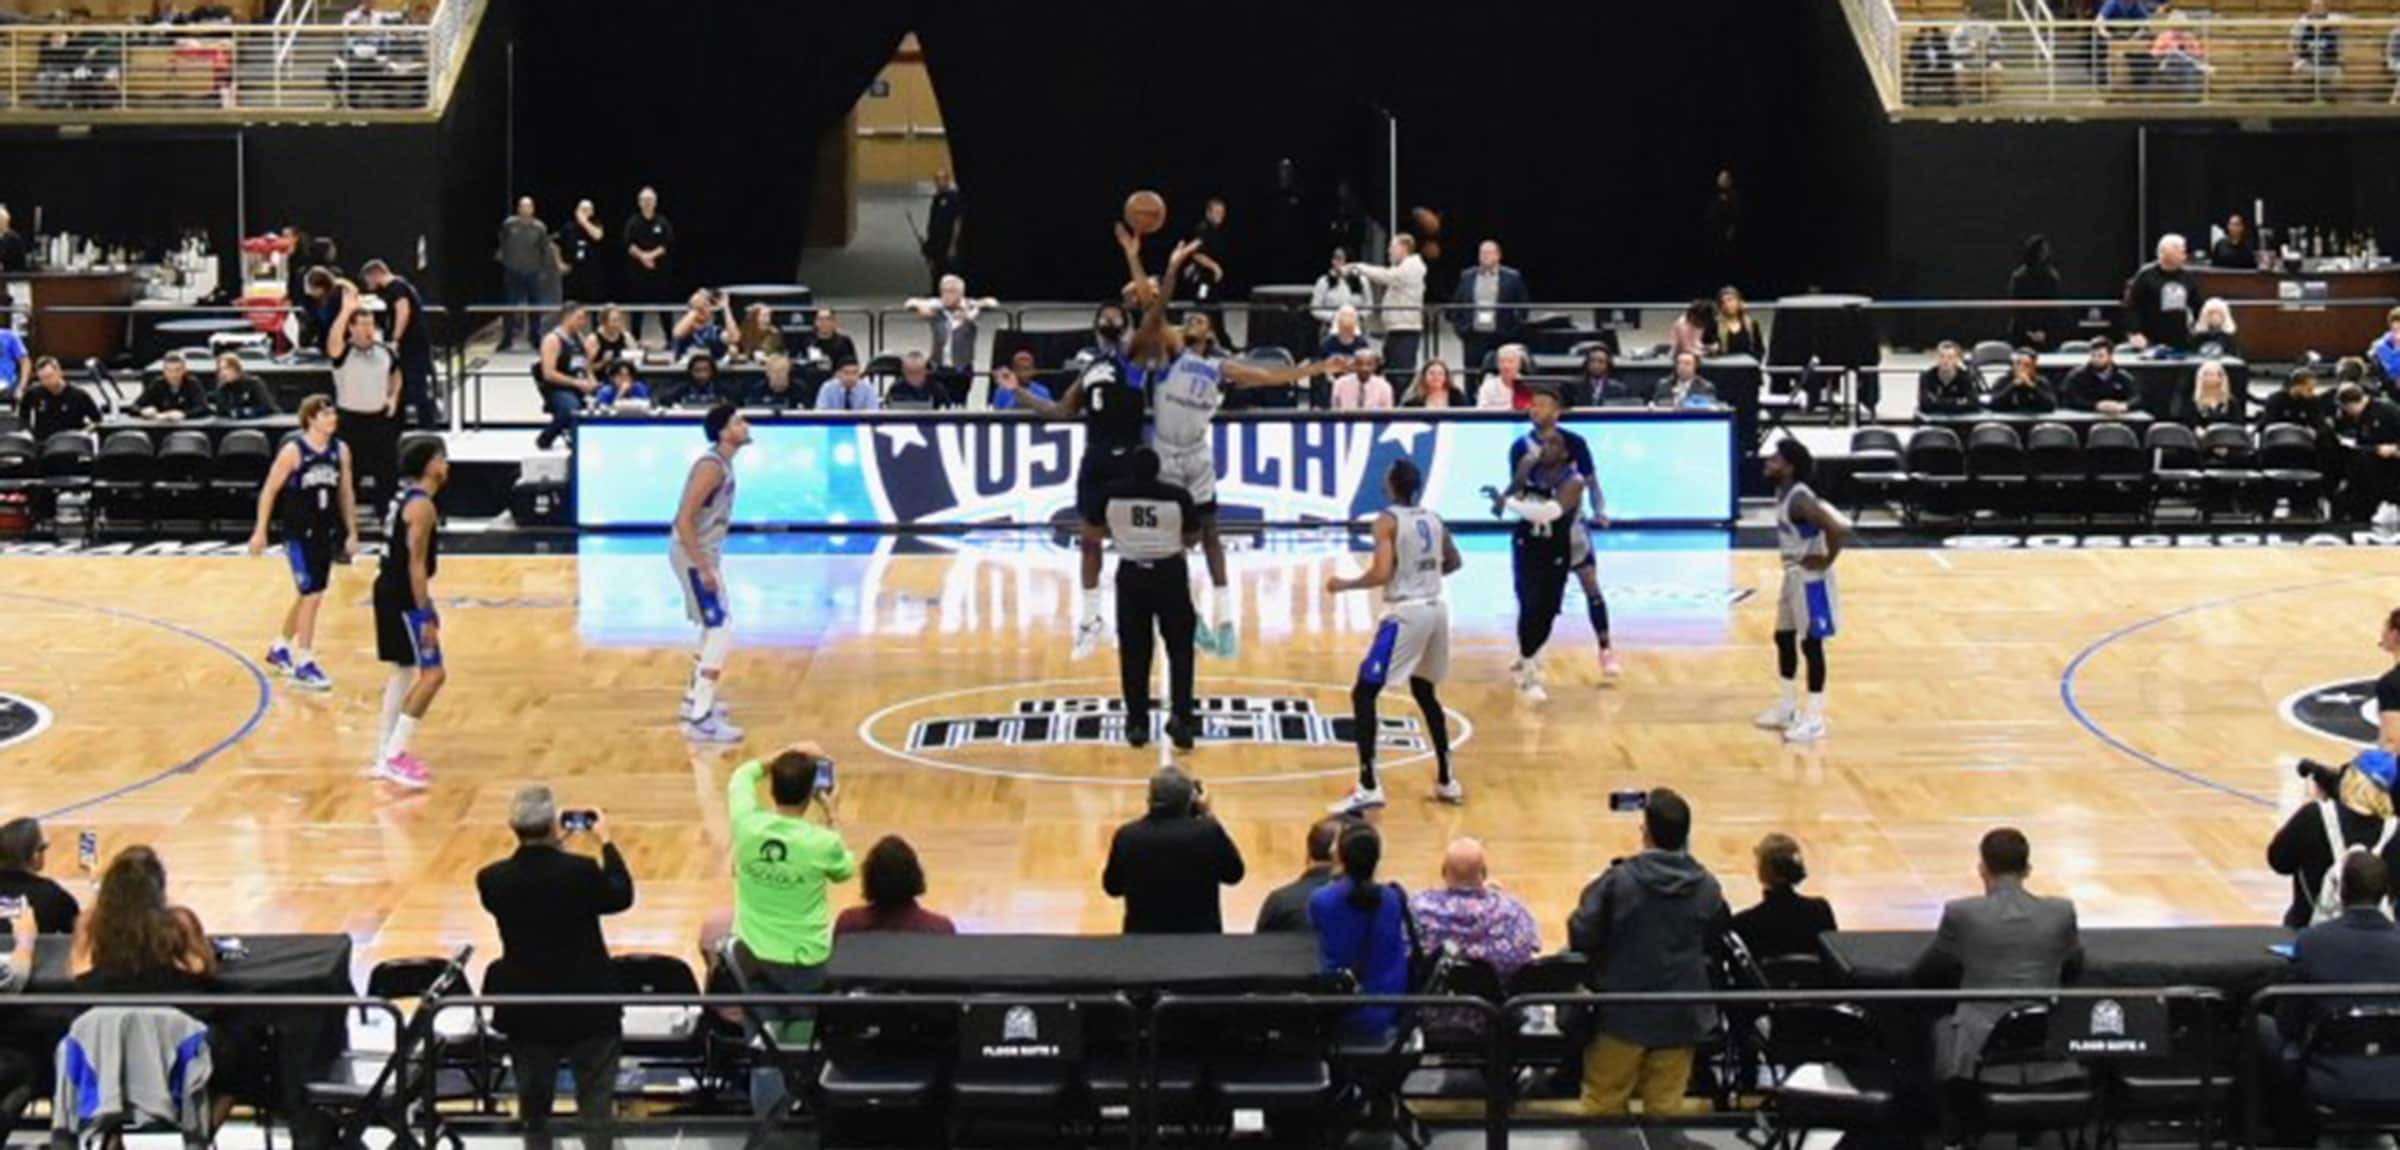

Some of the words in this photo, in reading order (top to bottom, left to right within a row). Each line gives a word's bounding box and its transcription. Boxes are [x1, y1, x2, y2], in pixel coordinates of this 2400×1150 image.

[974, 423, 1340, 499] OSLA
[1131, 505, 1158, 528] 85
[1415, 519, 1433, 555] 9
[1019, 698, 1310, 715] OSCOLA
